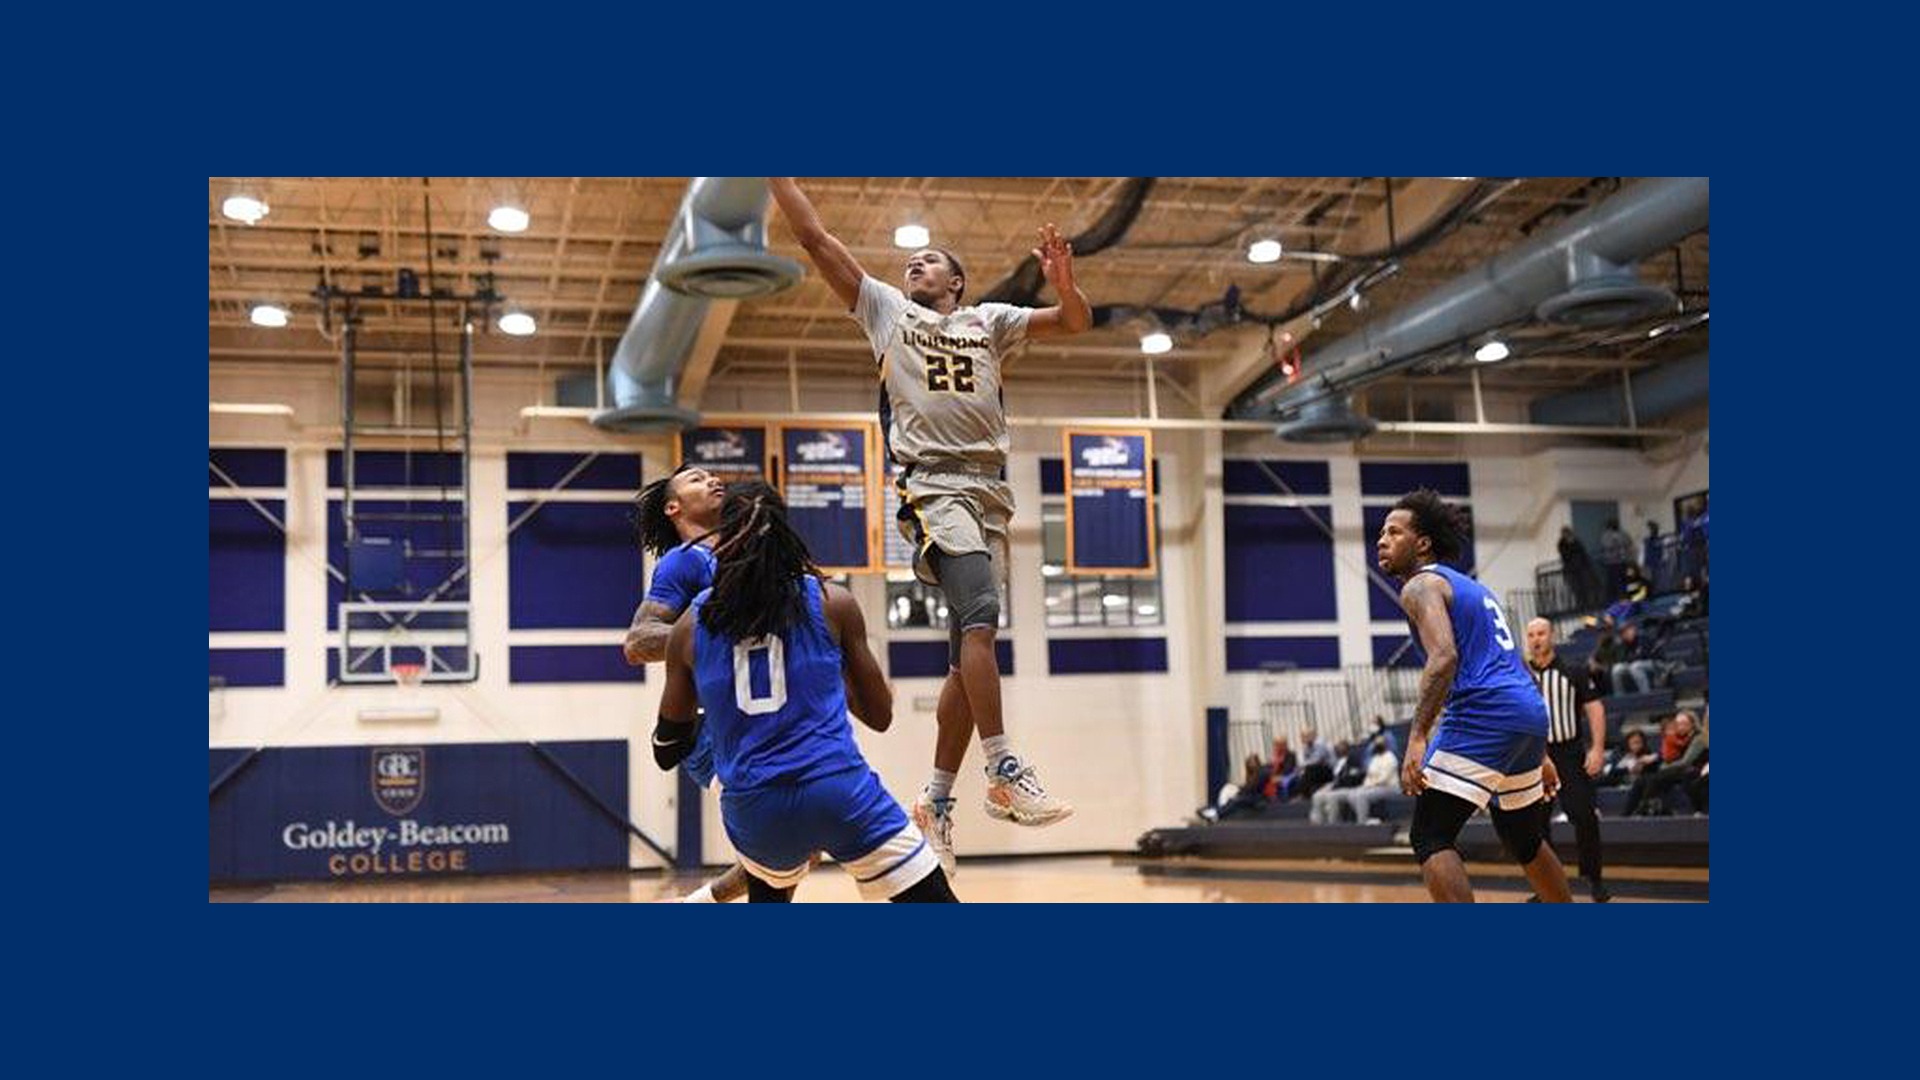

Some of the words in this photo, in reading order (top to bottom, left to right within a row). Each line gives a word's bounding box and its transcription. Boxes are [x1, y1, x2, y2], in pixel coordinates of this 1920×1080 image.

[903, 330, 990, 349] LIGHTNING
[926, 354, 975, 393] 22
[1483, 596, 1515, 651] 3
[733, 633, 787, 715] 0
[283, 820, 509, 854] Goldey-Beacom
[329, 852, 466, 874] COLLEGE
